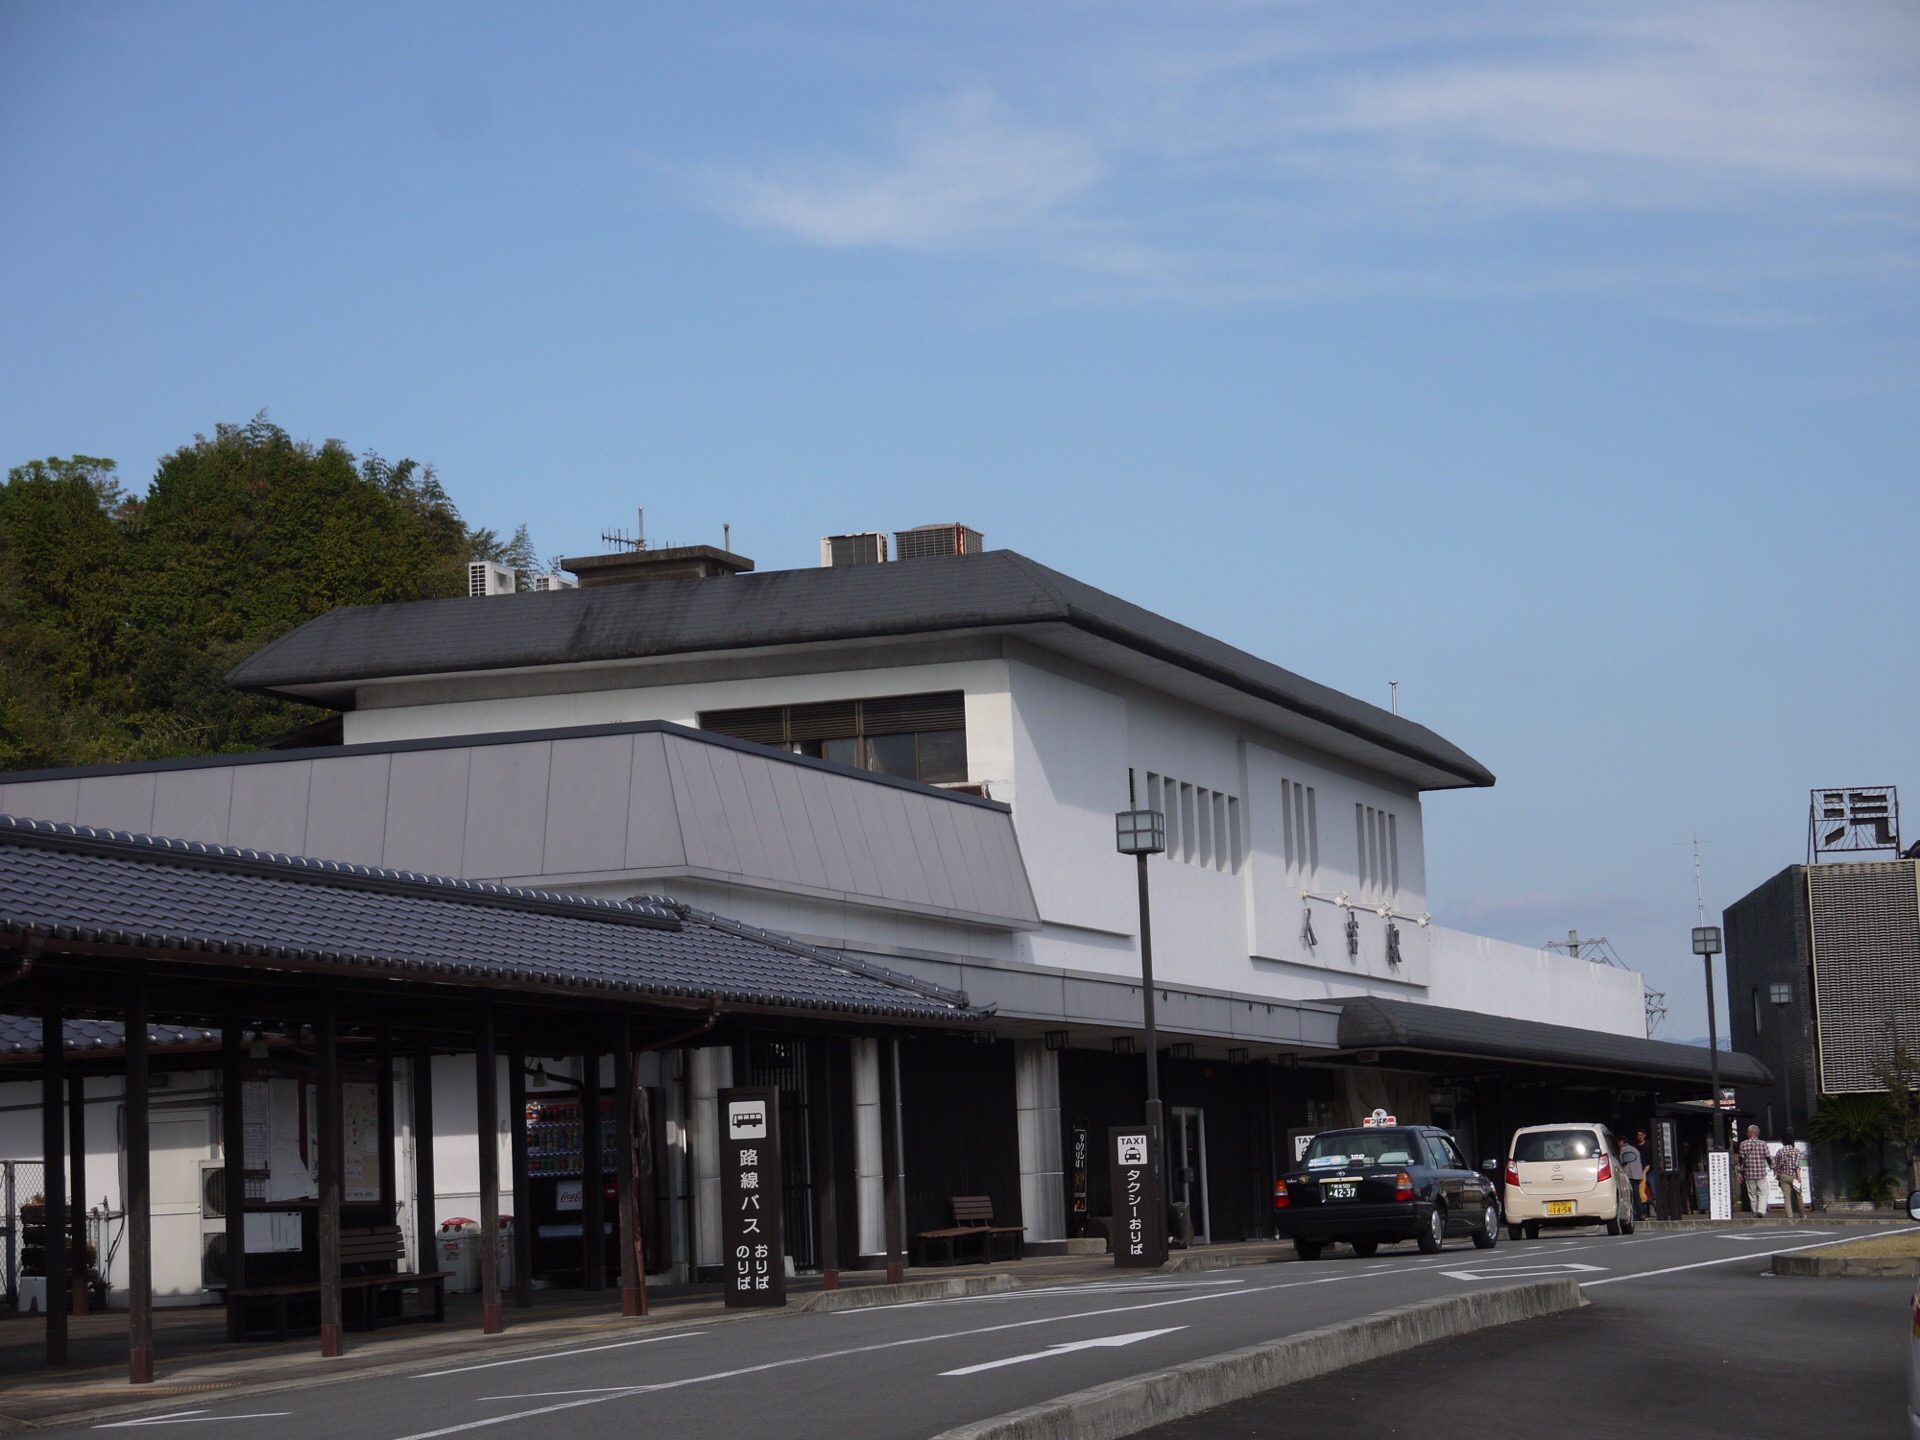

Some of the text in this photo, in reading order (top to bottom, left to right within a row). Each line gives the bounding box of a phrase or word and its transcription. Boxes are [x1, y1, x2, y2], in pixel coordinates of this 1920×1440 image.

[1120, 1137, 1144, 1145] TAXI
[1370, 1117, 1389, 1125] つばめ
[739, 1149, 761, 1235] 路線バス
[1126, 1169, 1143, 1255] タクシーおりば
[736, 1245, 751, 1290] のりば
[755, 1243, 770, 1290] おりば
